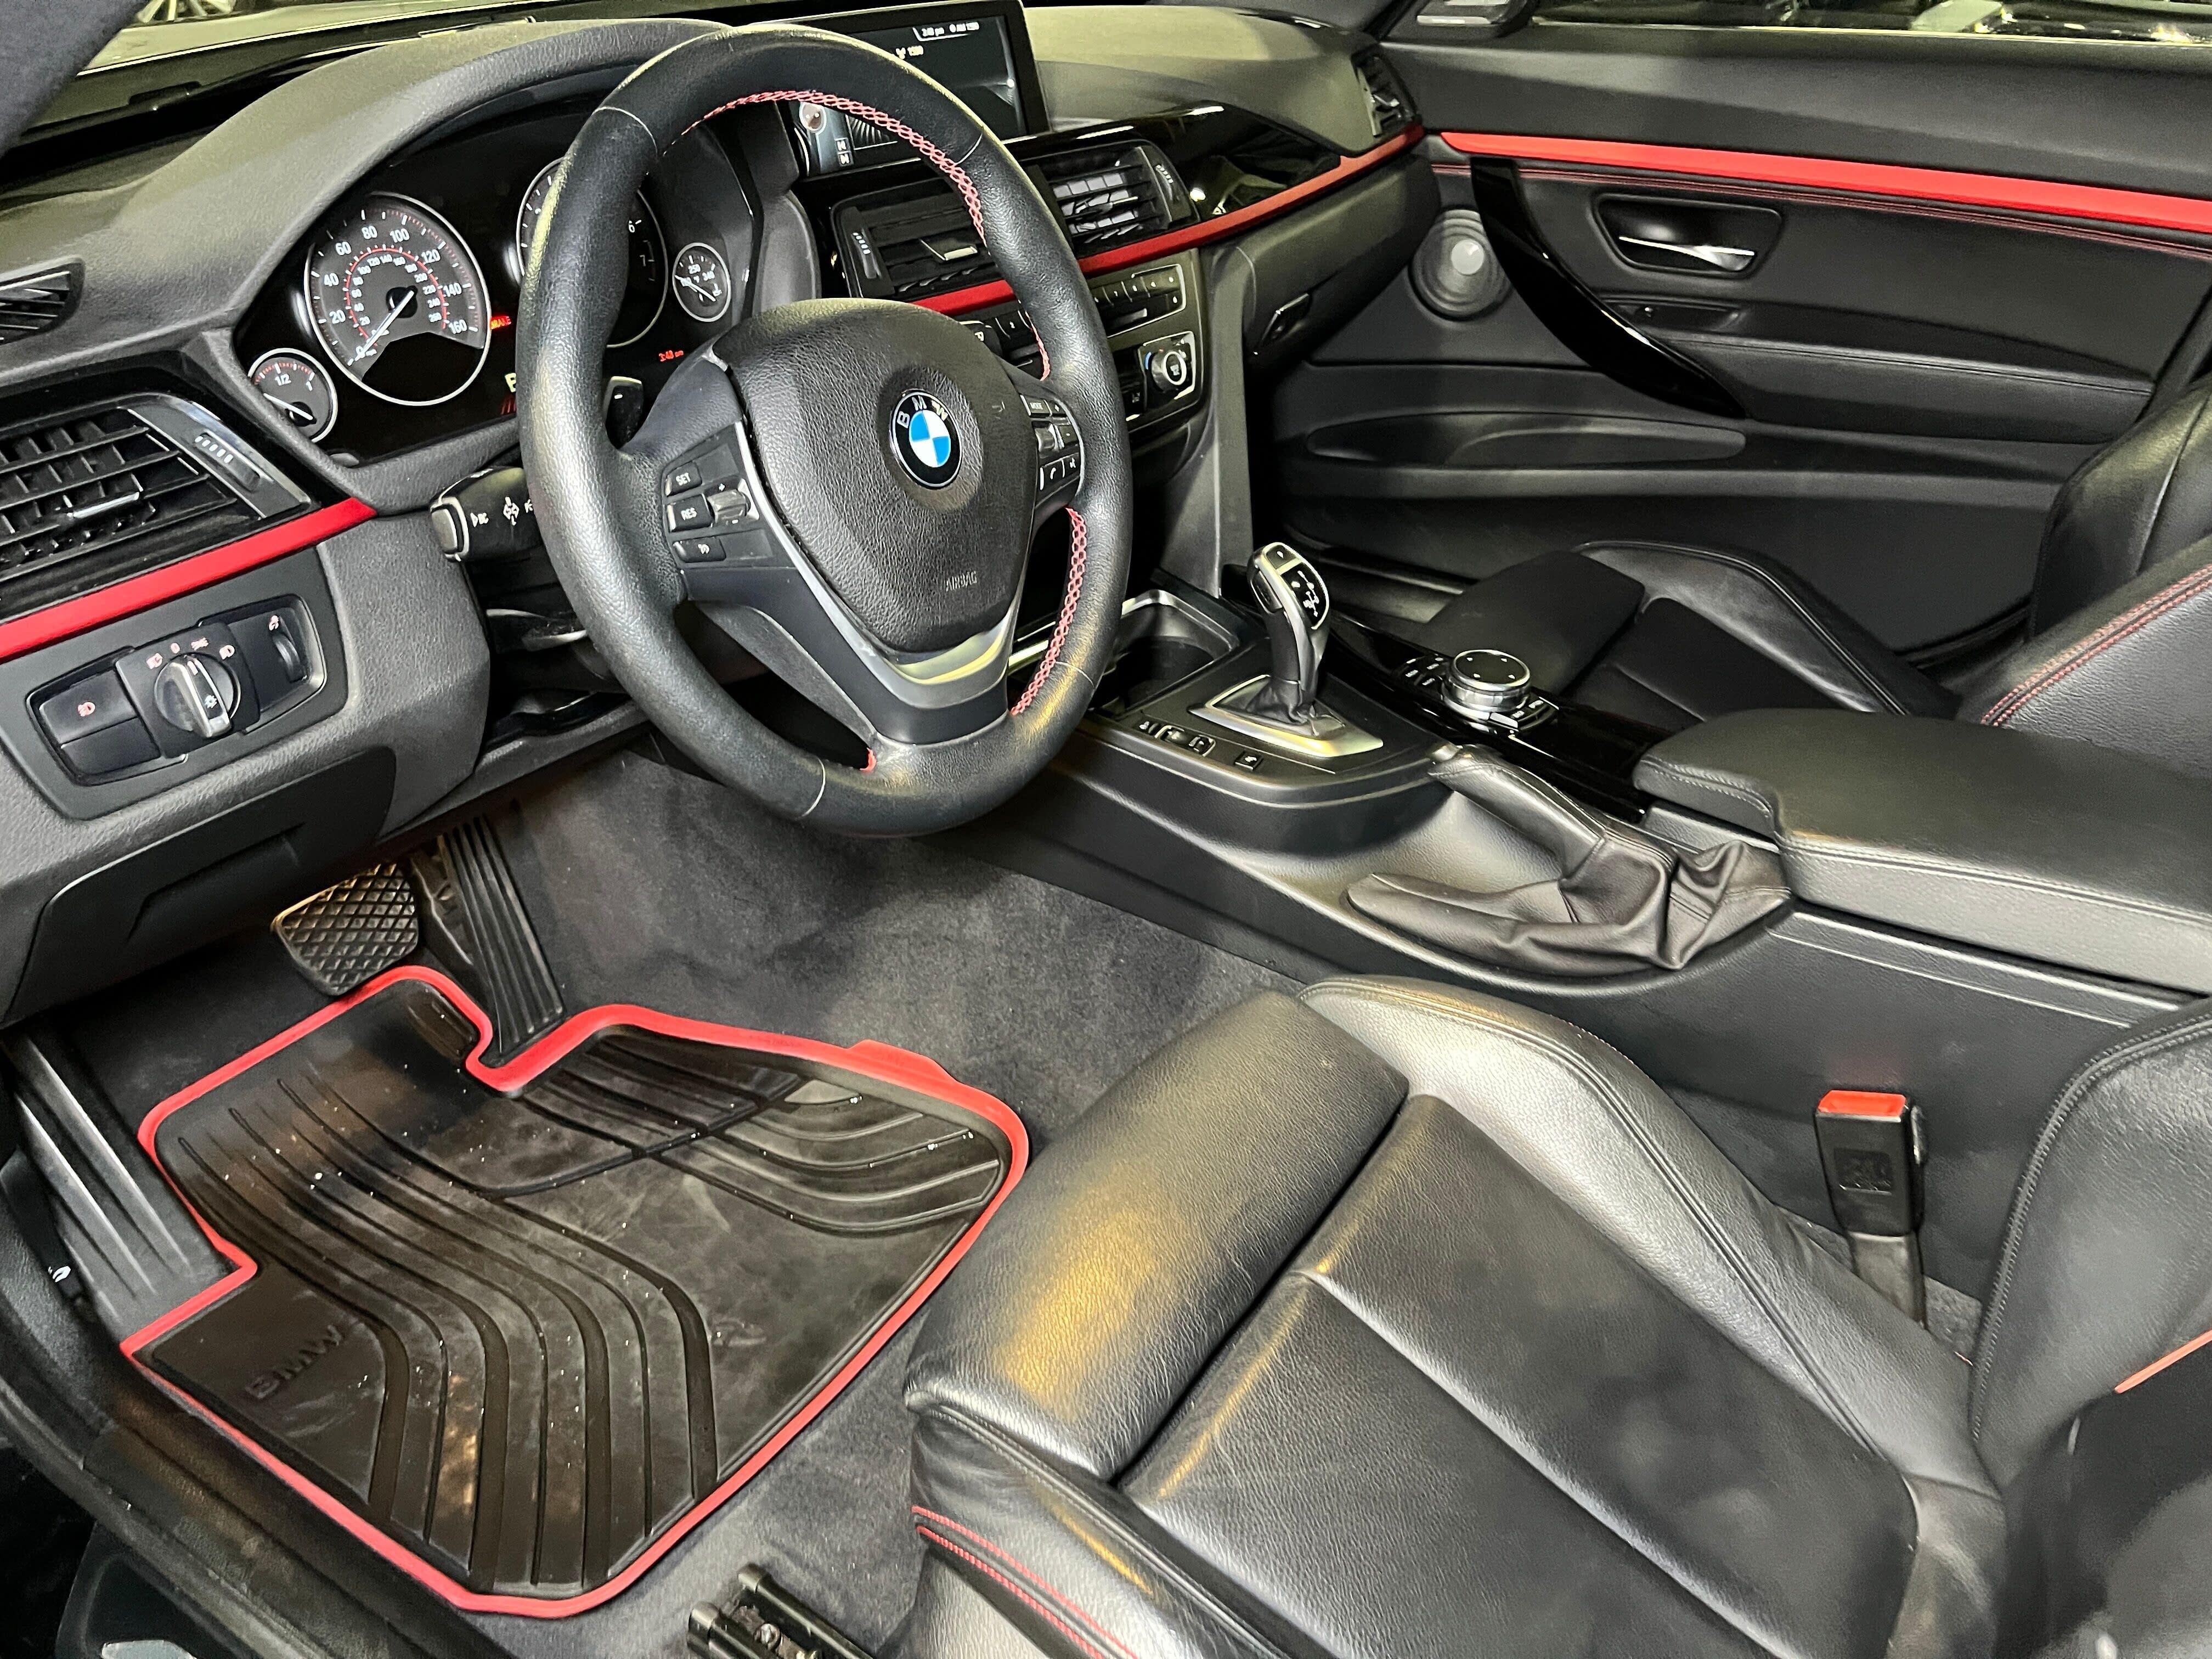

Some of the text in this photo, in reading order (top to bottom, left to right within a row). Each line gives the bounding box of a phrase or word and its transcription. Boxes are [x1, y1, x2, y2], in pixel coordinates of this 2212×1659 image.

[362, 225, 378, 240] 80
[390, 228, 410, 242] 100
[335, 241, 352, 256] 60
[421, 249, 441, 263] 120
[324, 273, 339, 287] 40
[443, 283, 462, 297] 140
[329, 309, 346, 324] 20
[449, 319, 467, 334] 160
[306, 381, 313, 391] 1
[897, 395, 949, 428] BMW
[675, 472, 691, 486] SET
[681, 507, 698, 521] RES
[946, 571, 978, 592] AIRBAG
[245, 1323, 346, 1401] BMW
